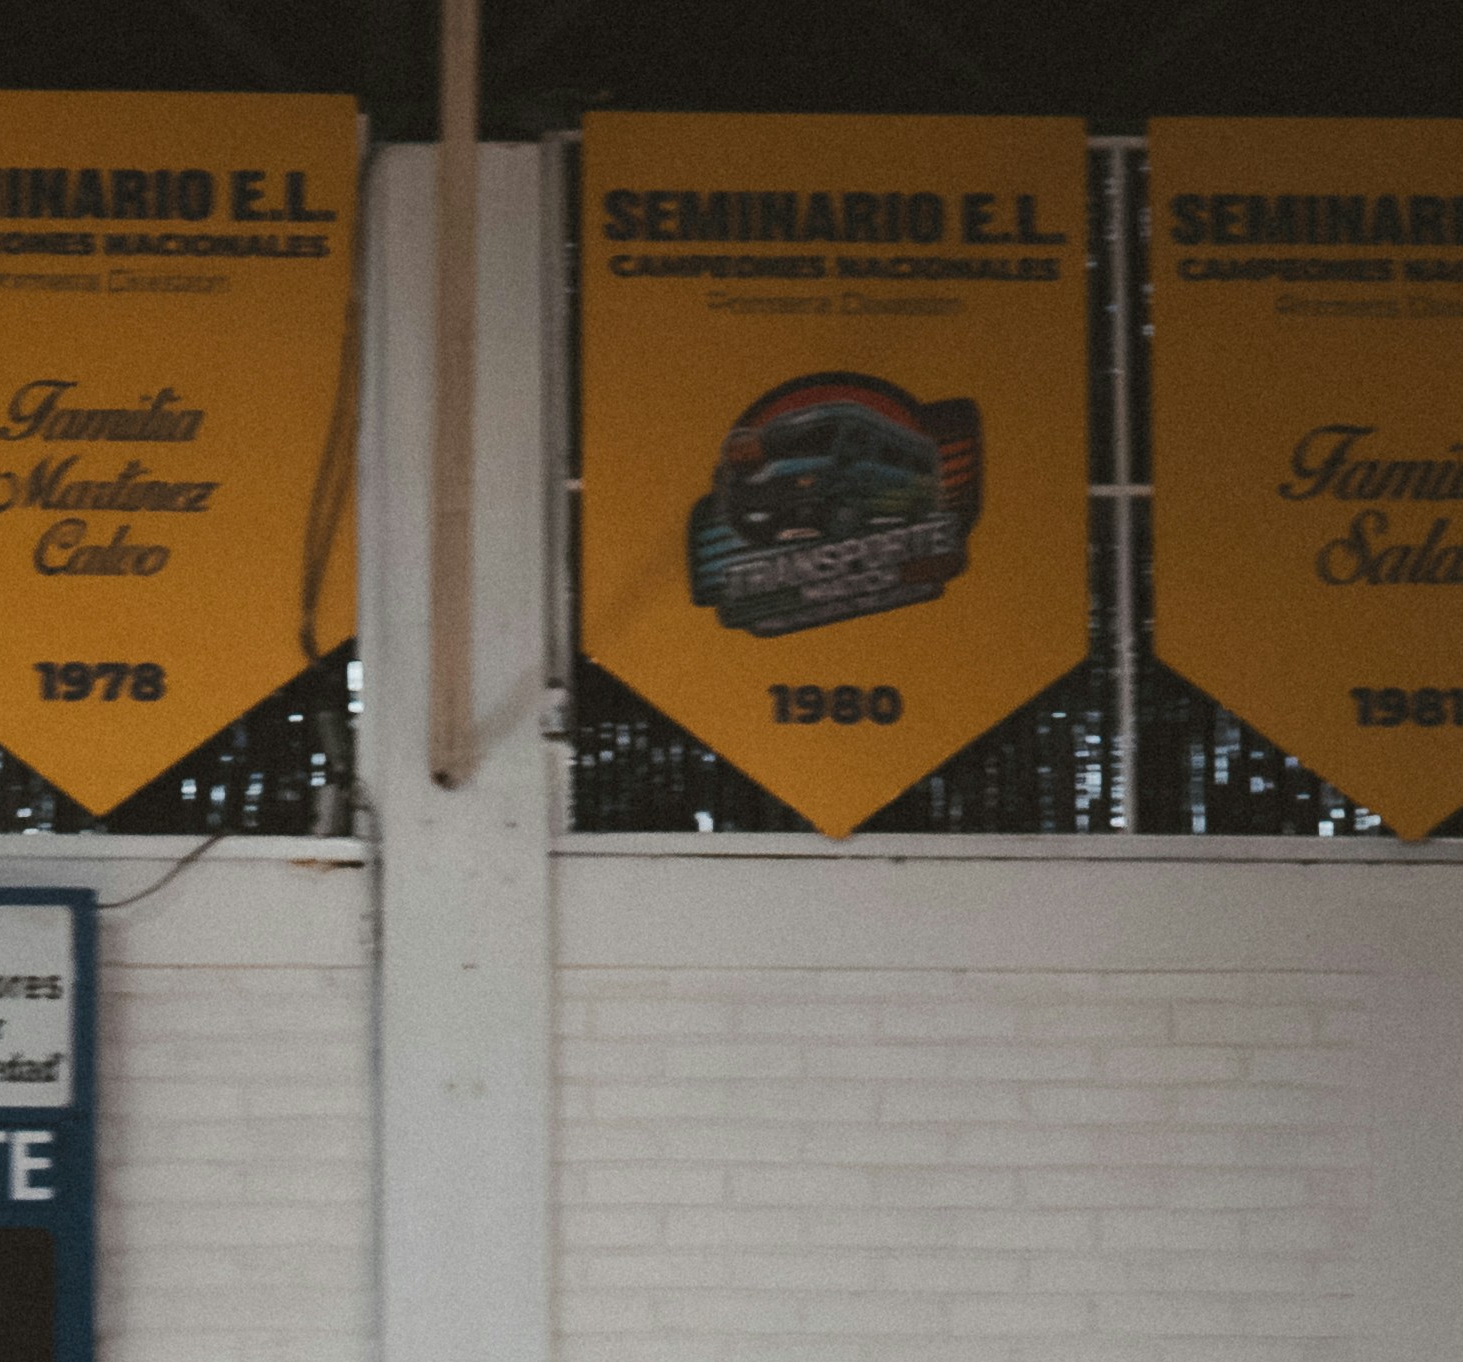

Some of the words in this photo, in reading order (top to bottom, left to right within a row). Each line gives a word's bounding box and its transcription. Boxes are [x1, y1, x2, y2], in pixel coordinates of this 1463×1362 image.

[602, 189, 945, 244] SEMINARIO
[103, 233, 330, 259] NACIONALES
[608, 254, 827, 279] CAMPEONES
[836, 257, 1060, 282] NACIONALES
[1178, 257, 1394, 283] CAMPEONES
[33, 661, 167, 702] 1978
[768, 684, 905, 727] 1980
